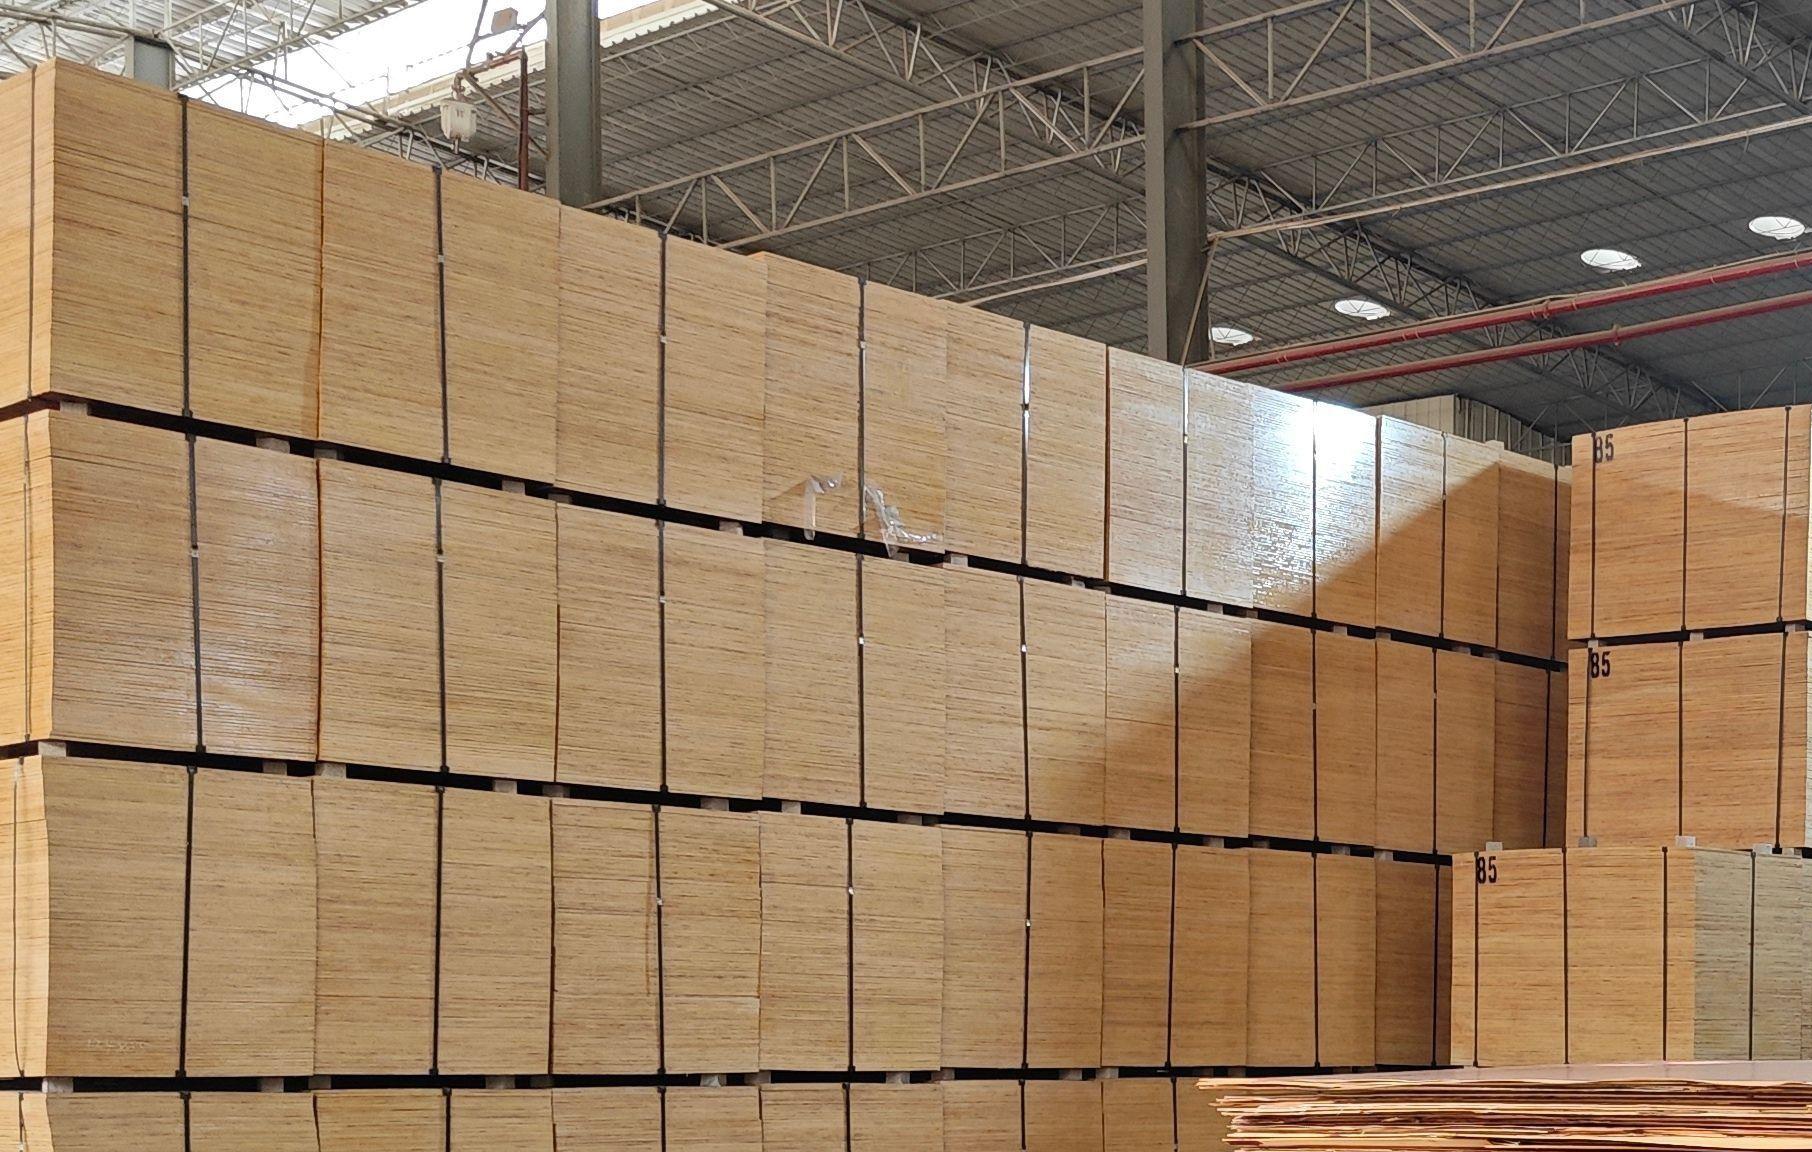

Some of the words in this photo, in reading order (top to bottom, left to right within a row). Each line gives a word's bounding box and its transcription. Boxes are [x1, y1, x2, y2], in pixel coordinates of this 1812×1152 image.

[1593, 433, 1614, 463] 85
[1590, 651, 1611, 678] 85
[1477, 855, 1497, 884] 85
